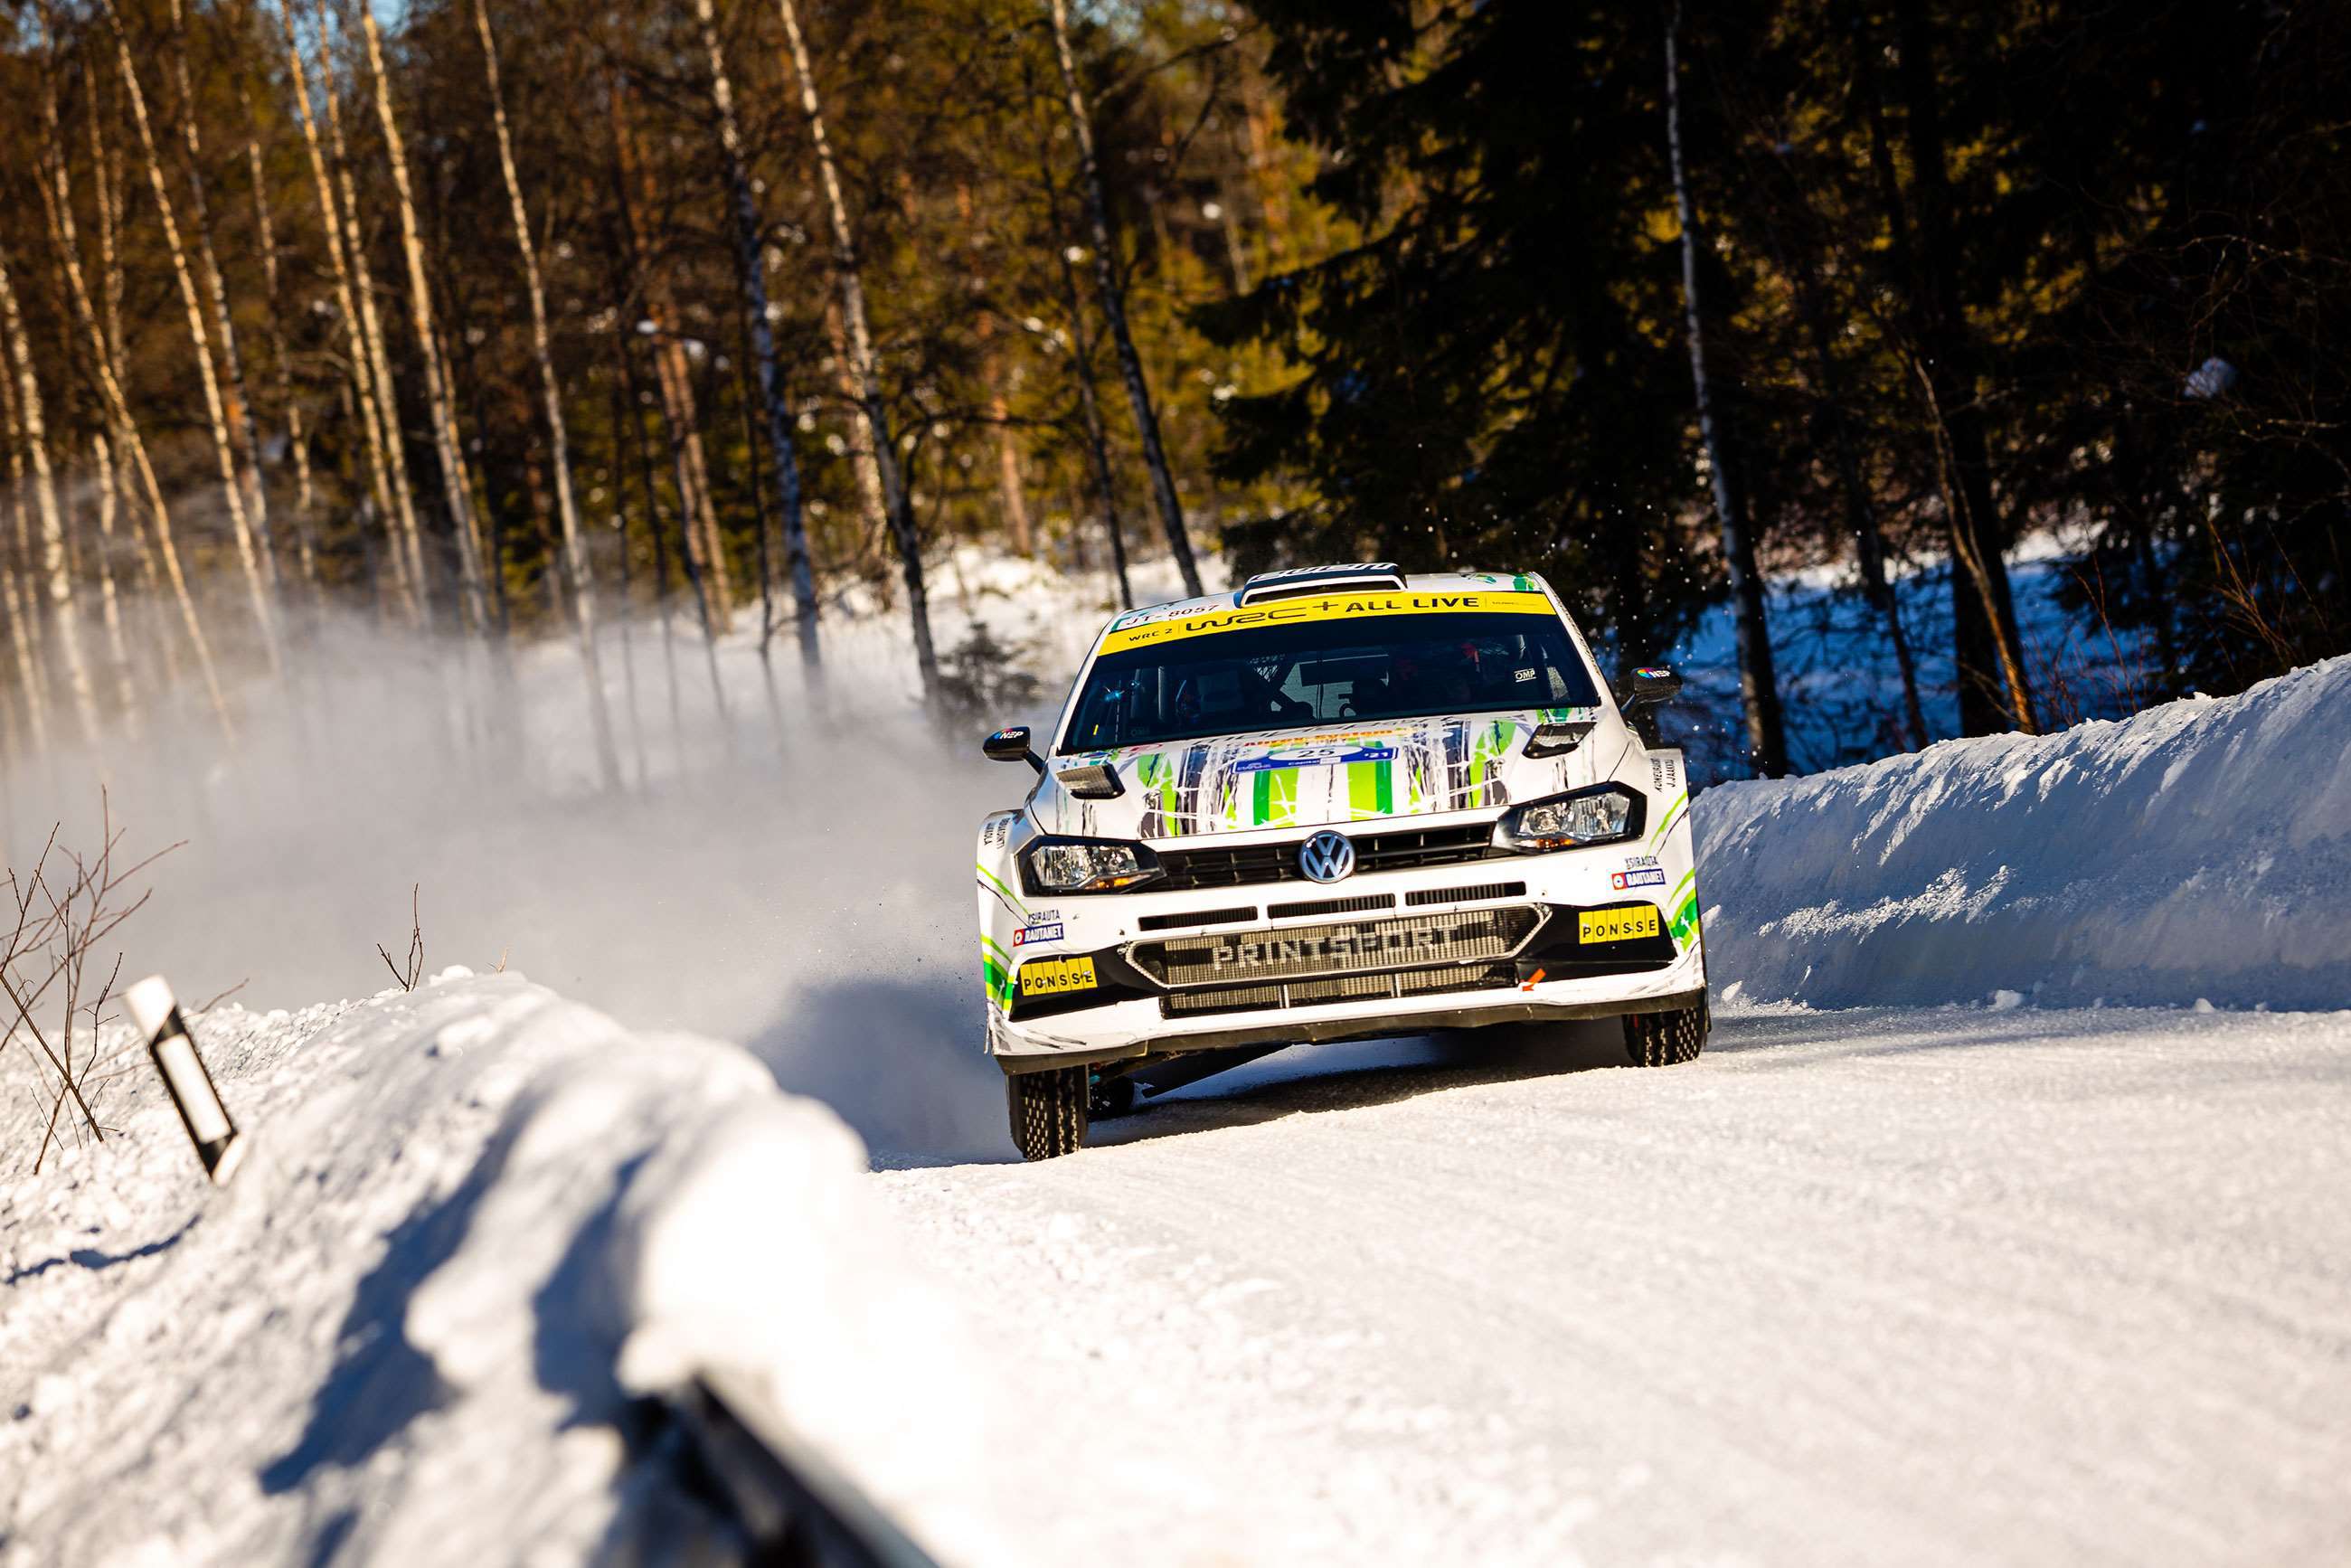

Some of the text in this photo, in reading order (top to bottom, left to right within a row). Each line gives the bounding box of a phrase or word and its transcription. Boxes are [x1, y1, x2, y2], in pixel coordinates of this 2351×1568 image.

[1345, 600, 1402, 612] ALL
[1413, 597, 1479, 609] LIVE
[1128, 631, 1160, 642] WRC
[1515, 669, 1535, 680] OMP
[1297, 749, 1335, 758] 25
[1582, 920, 1656, 938] PONSSE
[1212, 924, 1459, 971] PRINTSPORT
[1024, 971, 1093, 990] PONSSE
